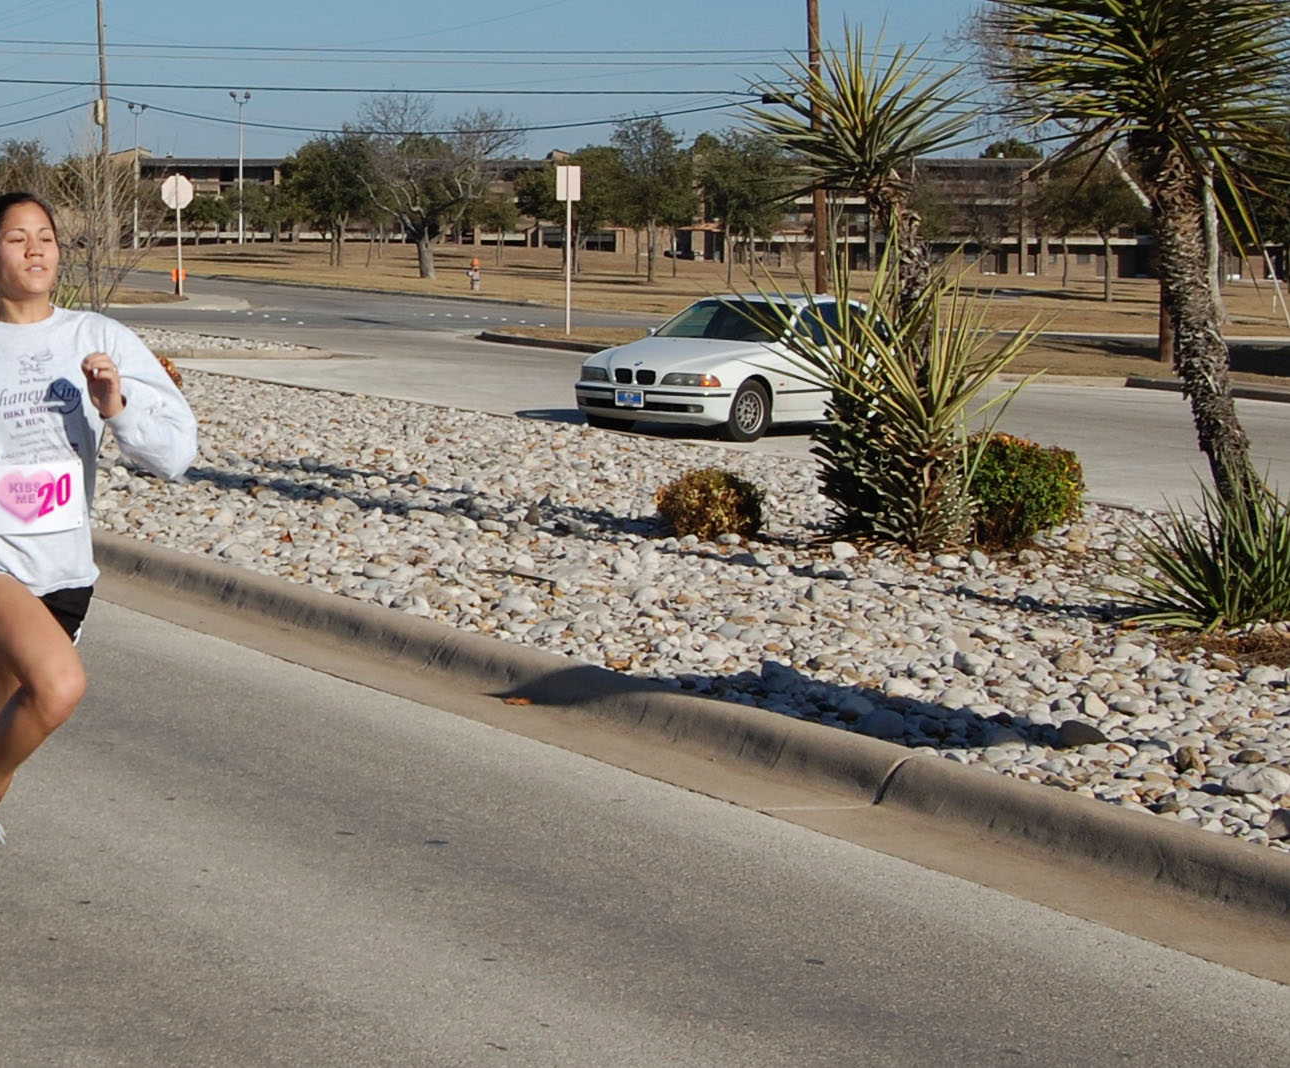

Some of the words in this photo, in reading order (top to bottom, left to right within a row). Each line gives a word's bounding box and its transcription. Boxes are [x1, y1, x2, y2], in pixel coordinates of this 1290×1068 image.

[3, 409, 25, 420] BIKE
[15, 421, 22, 429] &
[25, 417, 45, 428] RUN
[9, 482, 41, 493] KISS
[15, 494, 37, 504] ME
[36, 472, 72, 518] 20
